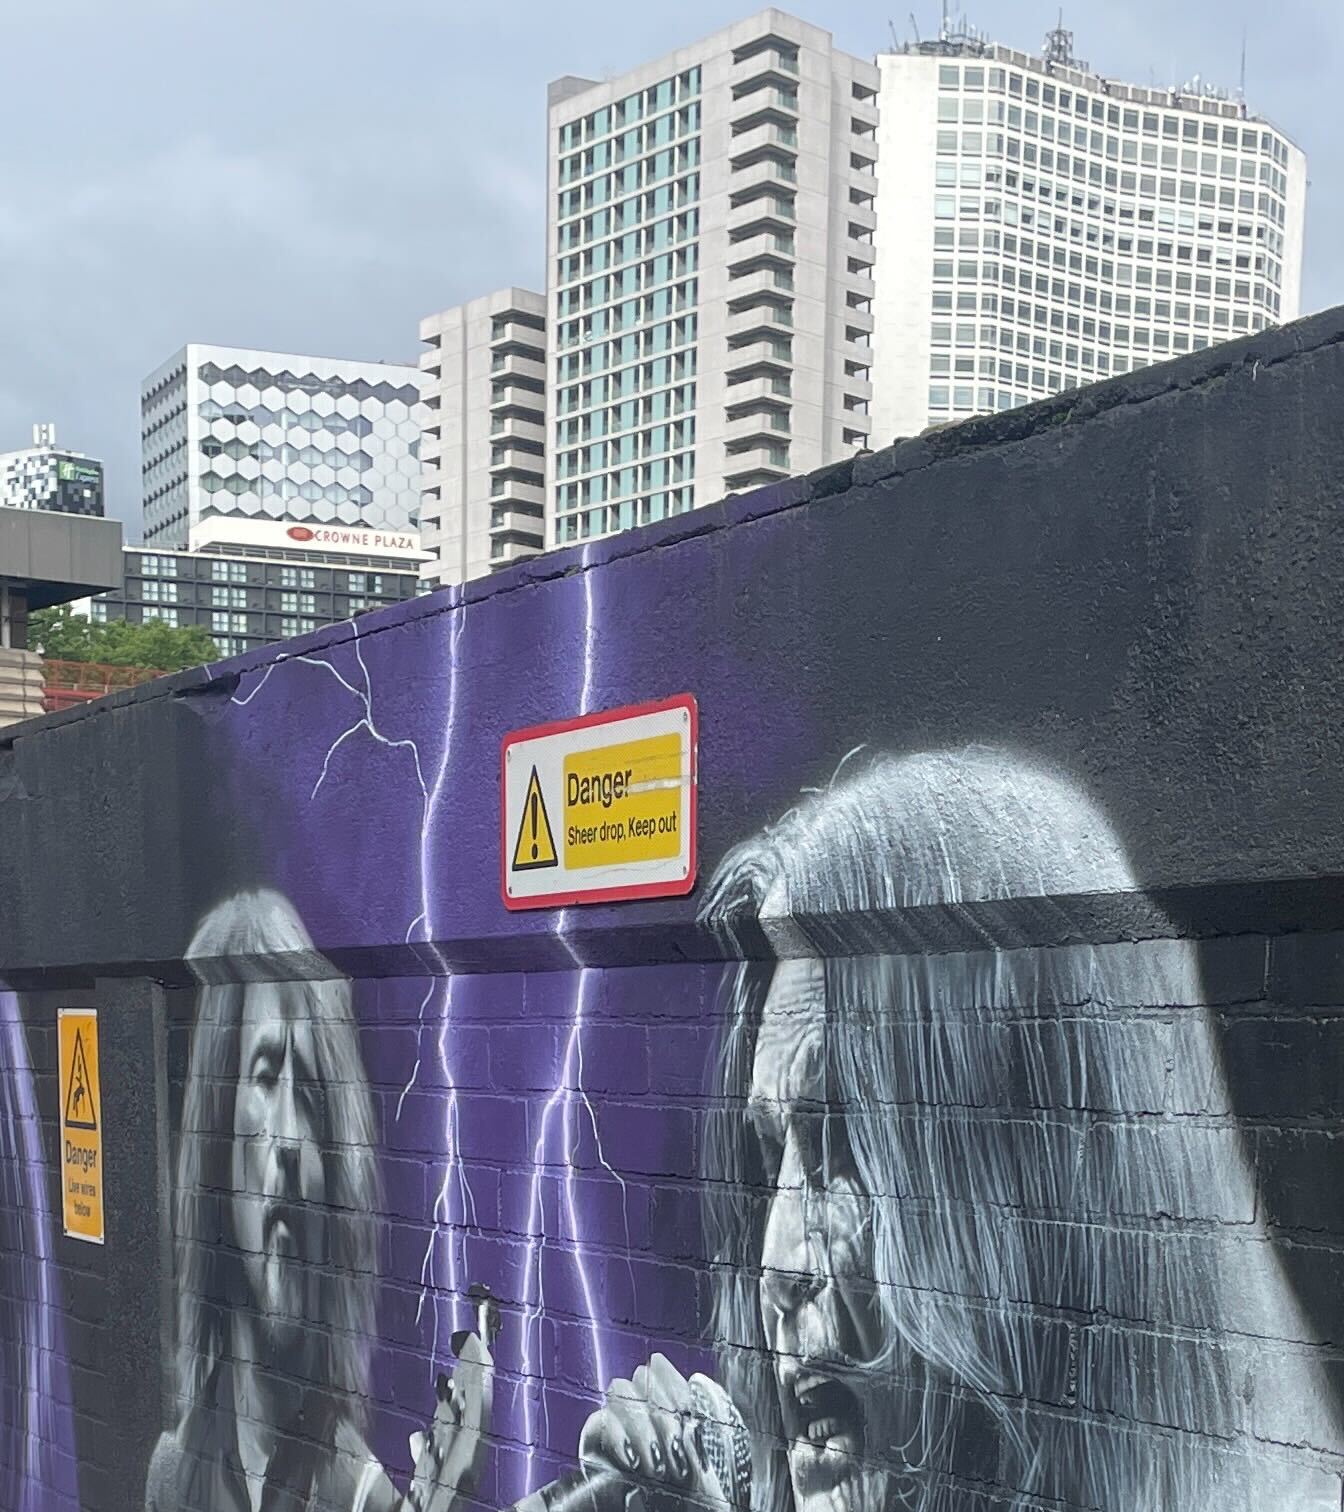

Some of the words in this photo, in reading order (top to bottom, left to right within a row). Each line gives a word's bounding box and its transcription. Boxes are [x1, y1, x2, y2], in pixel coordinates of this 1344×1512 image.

[314, 530, 369, 546] CROWNE
[374, 535, 414, 550] PLAZA
[567, 768, 632, 808] Danger
[567, 825, 597, 846] Sheer
[599, 820, 626, 844] drop,
[628, 816, 656, 840] Keep
[658, 811, 677, 833] out
[65, 1139, 97, 1174] Danger
